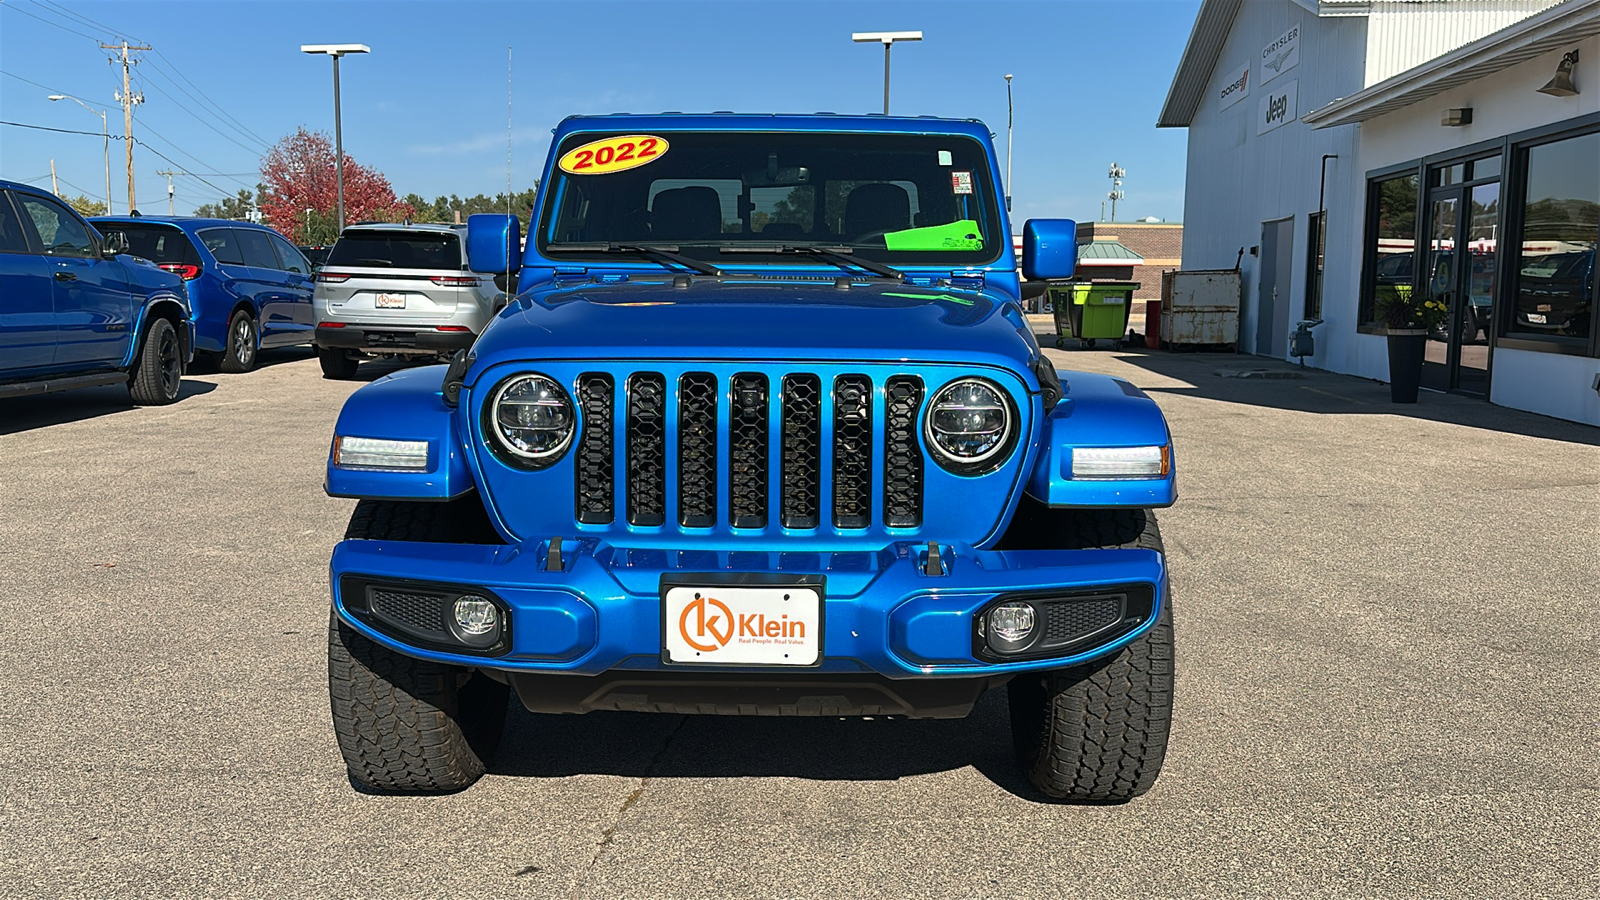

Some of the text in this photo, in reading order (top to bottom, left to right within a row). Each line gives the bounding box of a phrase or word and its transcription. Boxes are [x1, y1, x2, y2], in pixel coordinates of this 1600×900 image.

[1262, 28, 1298, 58] CHRYSLER
[1220, 77, 1244, 98] DODGE
[1265, 94, 1287, 124] Jeep
[572, 138, 658, 170] 2022
[738, 613, 805, 638] Klein
